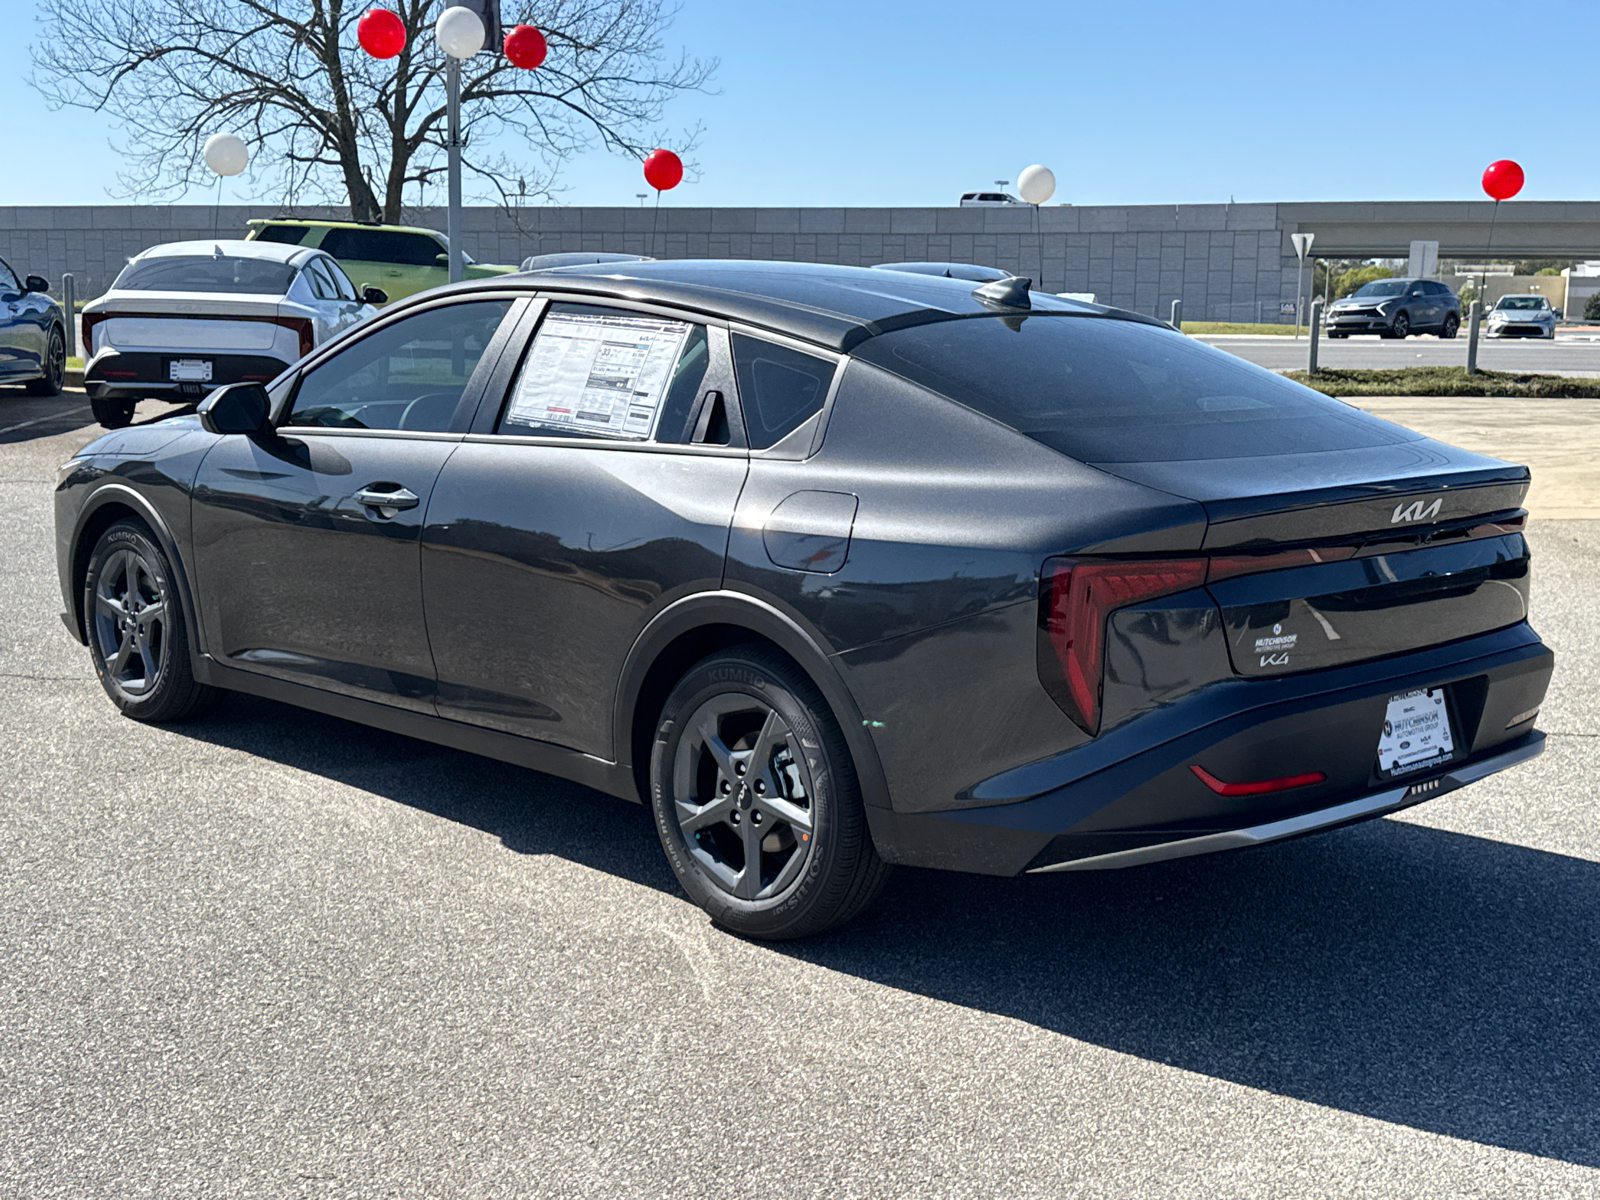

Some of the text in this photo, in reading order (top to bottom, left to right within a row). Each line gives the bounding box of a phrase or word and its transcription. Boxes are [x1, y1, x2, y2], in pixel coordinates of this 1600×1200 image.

[1391, 498, 1443, 523] KIA
[107, 531, 138, 545] KUMHO
[1255, 633, 1298, 647] HUTCHINSON
[1260, 652, 1289, 667] K4
[707, 667, 767, 690] KUMHO
[1394, 711, 1439, 733] HUTCHINSON
[1397, 722, 1439, 739] AUTOMOTIVE GROUP
[665, 837, 686, 875] 205/55
[788, 844, 824, 910] SOLUS
